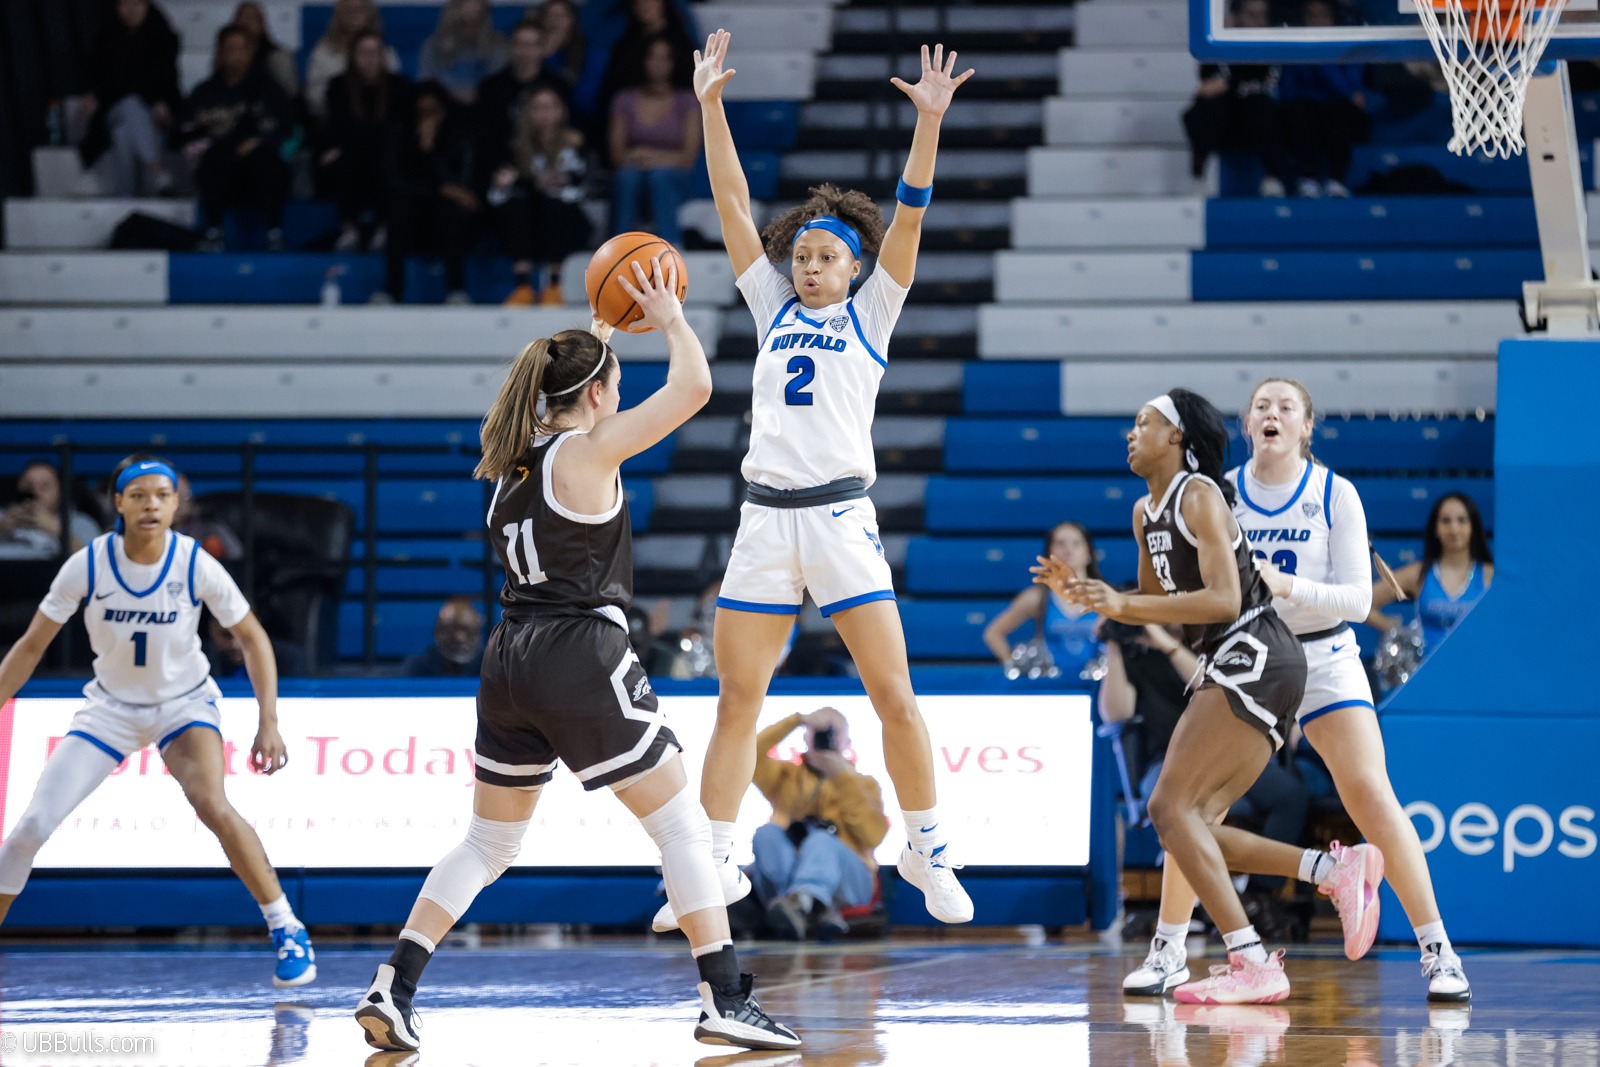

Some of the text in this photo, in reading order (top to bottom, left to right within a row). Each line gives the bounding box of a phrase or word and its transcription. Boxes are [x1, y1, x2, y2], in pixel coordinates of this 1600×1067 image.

[769, 333, 847, 352] BUFFALO
[784, 355, 815, 406] 2
[1146, 530, 1173, 555] ESTERN
[1246, 529, 1311, 542] UFFALO
[502, 518, 549, 586] 11
[1254, 549, 1298, 576] 3
[103, 608, 177, 624] BUFFALO
[130, 631, 147, 667] 1
[940, 745, 1044, 774] ves
